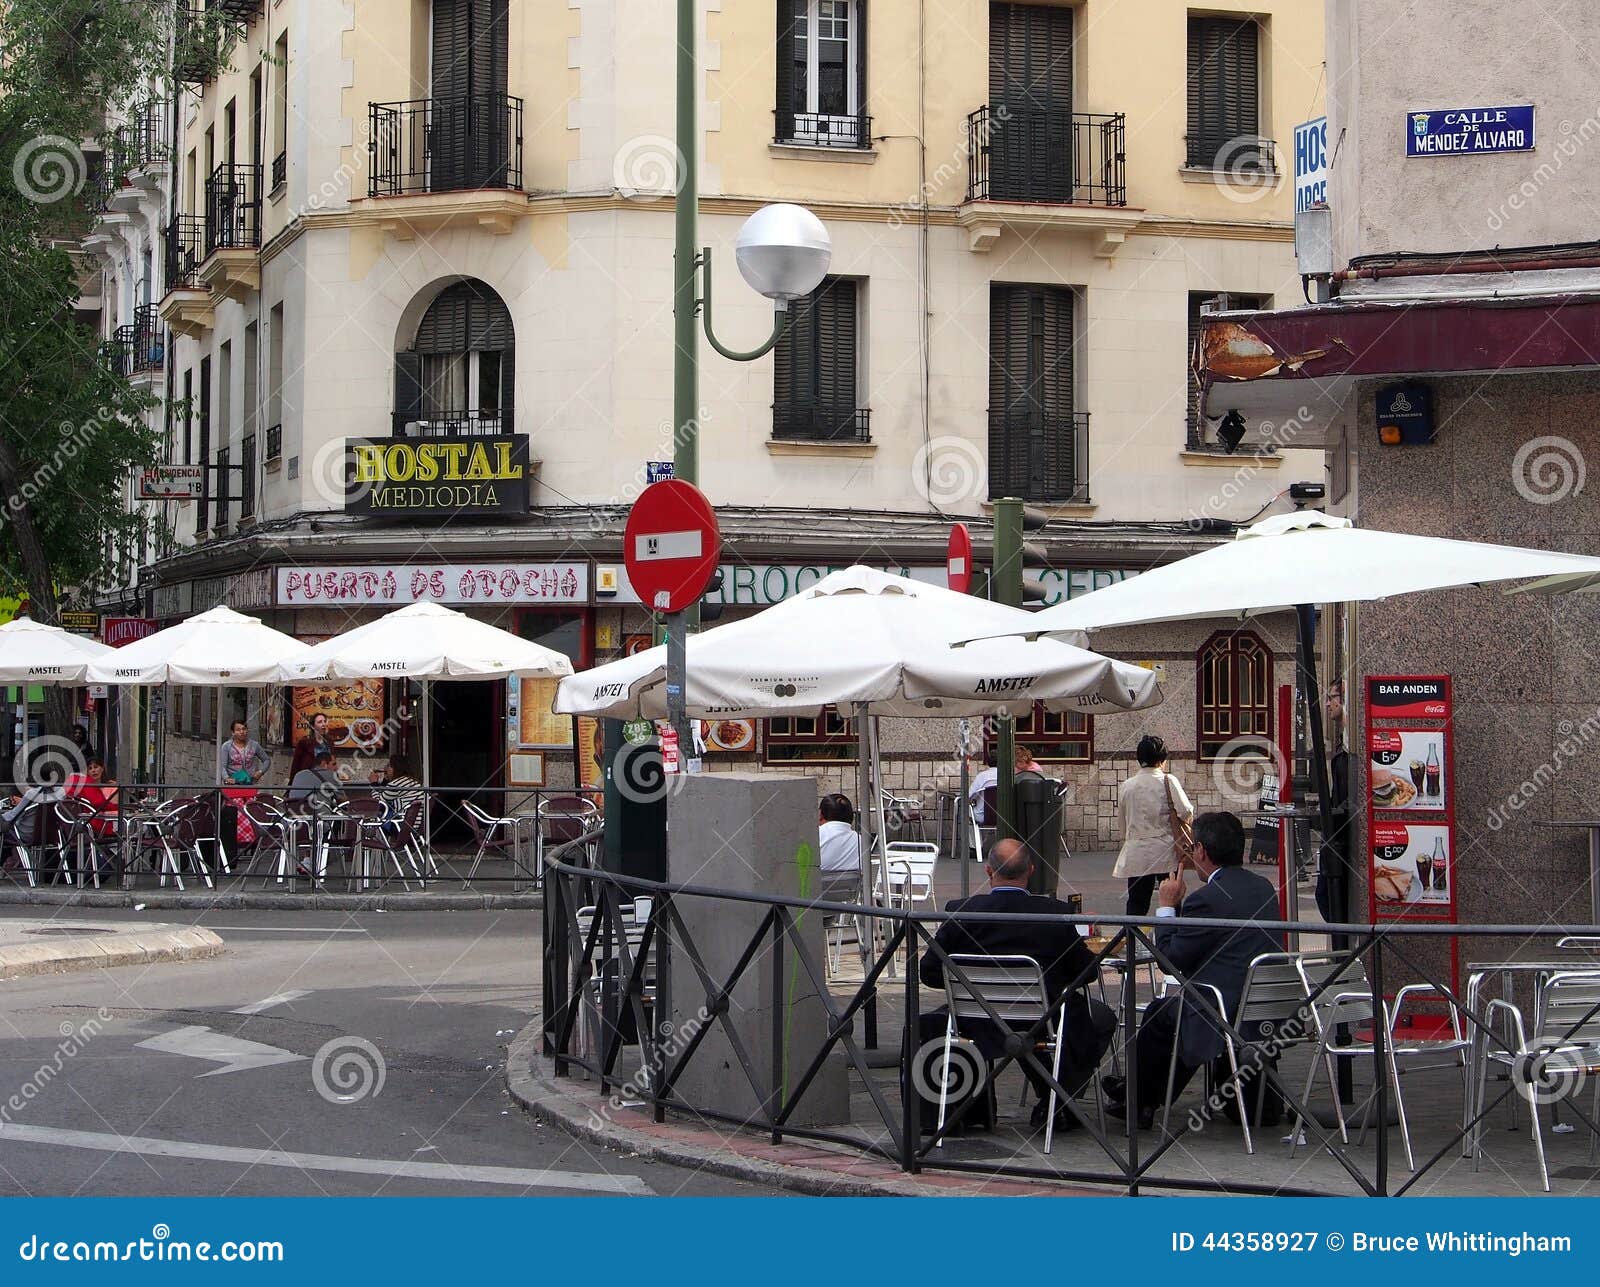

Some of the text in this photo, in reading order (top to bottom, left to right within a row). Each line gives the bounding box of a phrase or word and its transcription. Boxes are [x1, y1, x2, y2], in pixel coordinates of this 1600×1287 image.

[1444, 111, 1507, 124] CALLE
[1462, 124, 1480, 133] DE
[352, 441, 523, 482] HOSTAL
[285, 568, 578, 600] PUERTA DE ATOCHA
[28, 666, 62, 675] AMSTEL
[371, 661, 407, 671] AMSTEL
[115, 668, 141, 677] AMSTEL
[974, 676, 1036, 693] AMSTEL
[1379, 685, 1437, 694] BAR ANDEN
